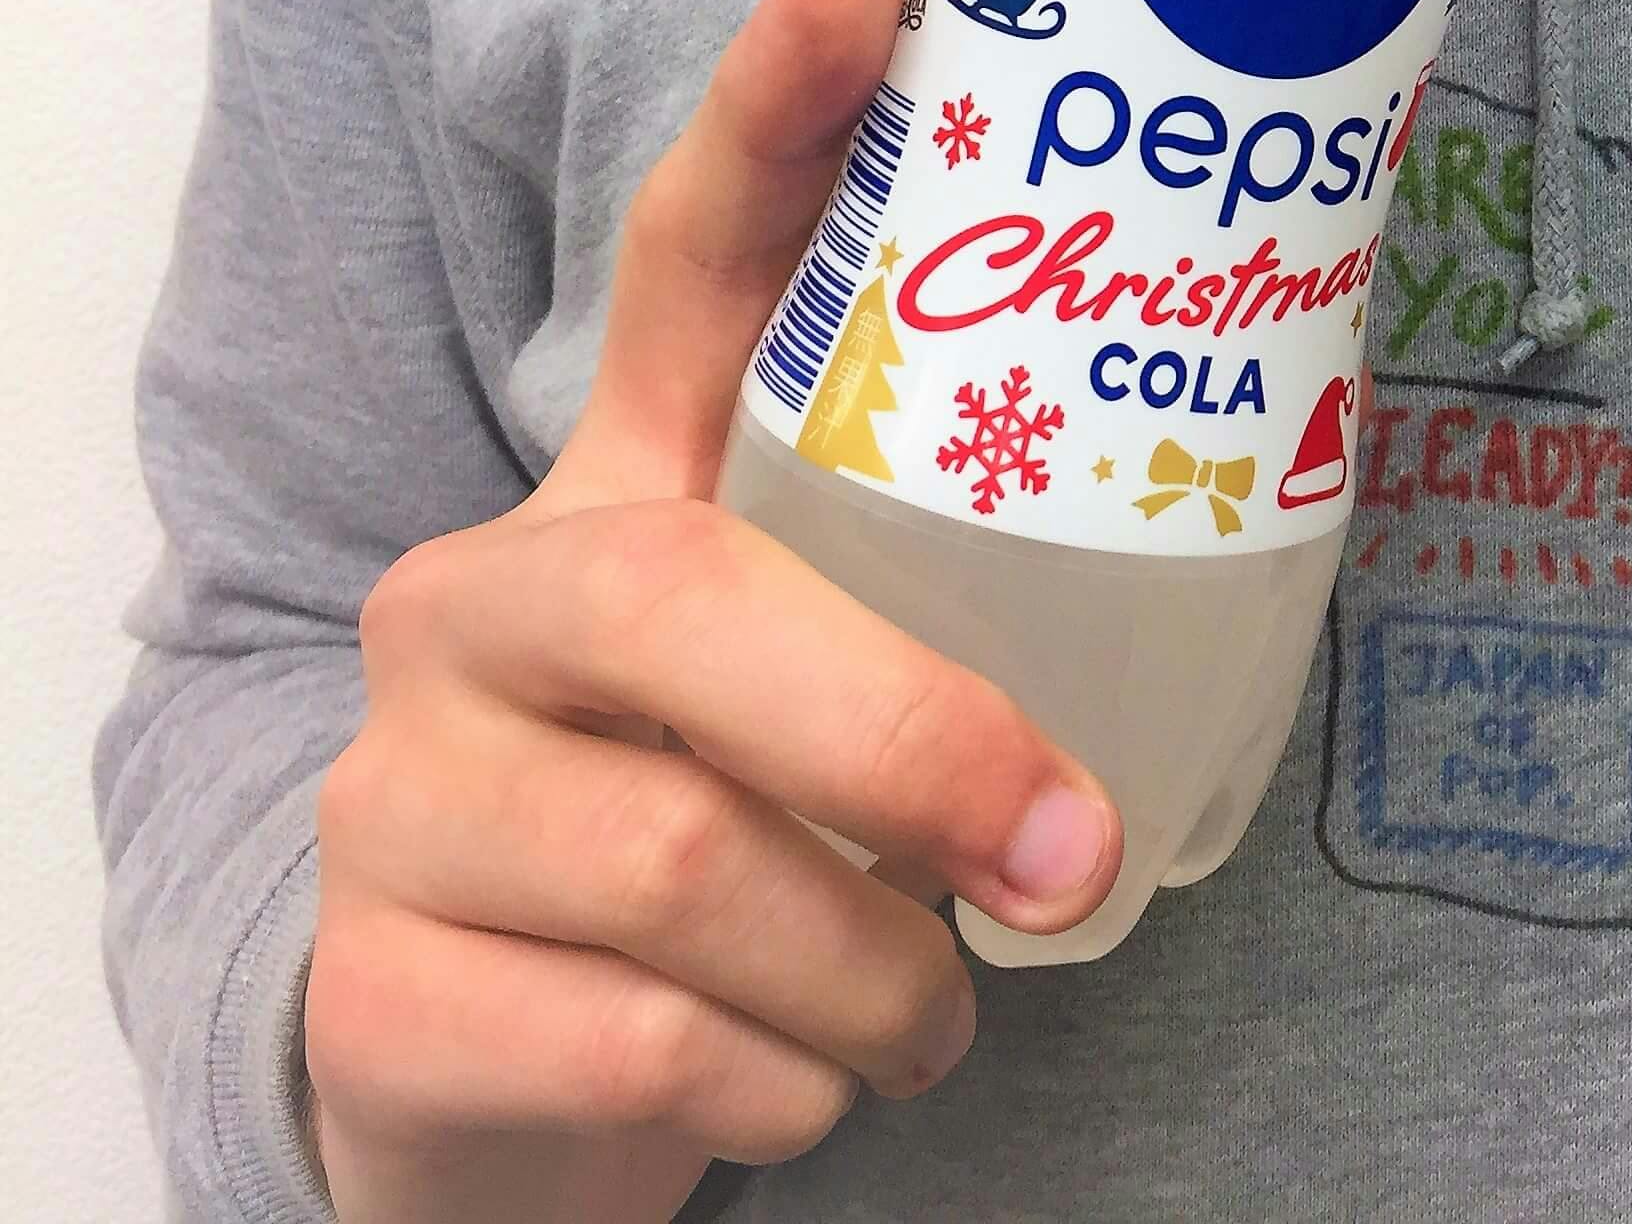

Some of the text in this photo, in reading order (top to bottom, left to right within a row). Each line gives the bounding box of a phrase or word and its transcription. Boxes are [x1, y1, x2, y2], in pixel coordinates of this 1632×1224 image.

[1026, 71, 1402, 229] pepsi
[896, 210, 1382, 337] Christmas
[1089, 342, 1266, 416] COLA
[1400, 642, 1607, 701] JAPAN
